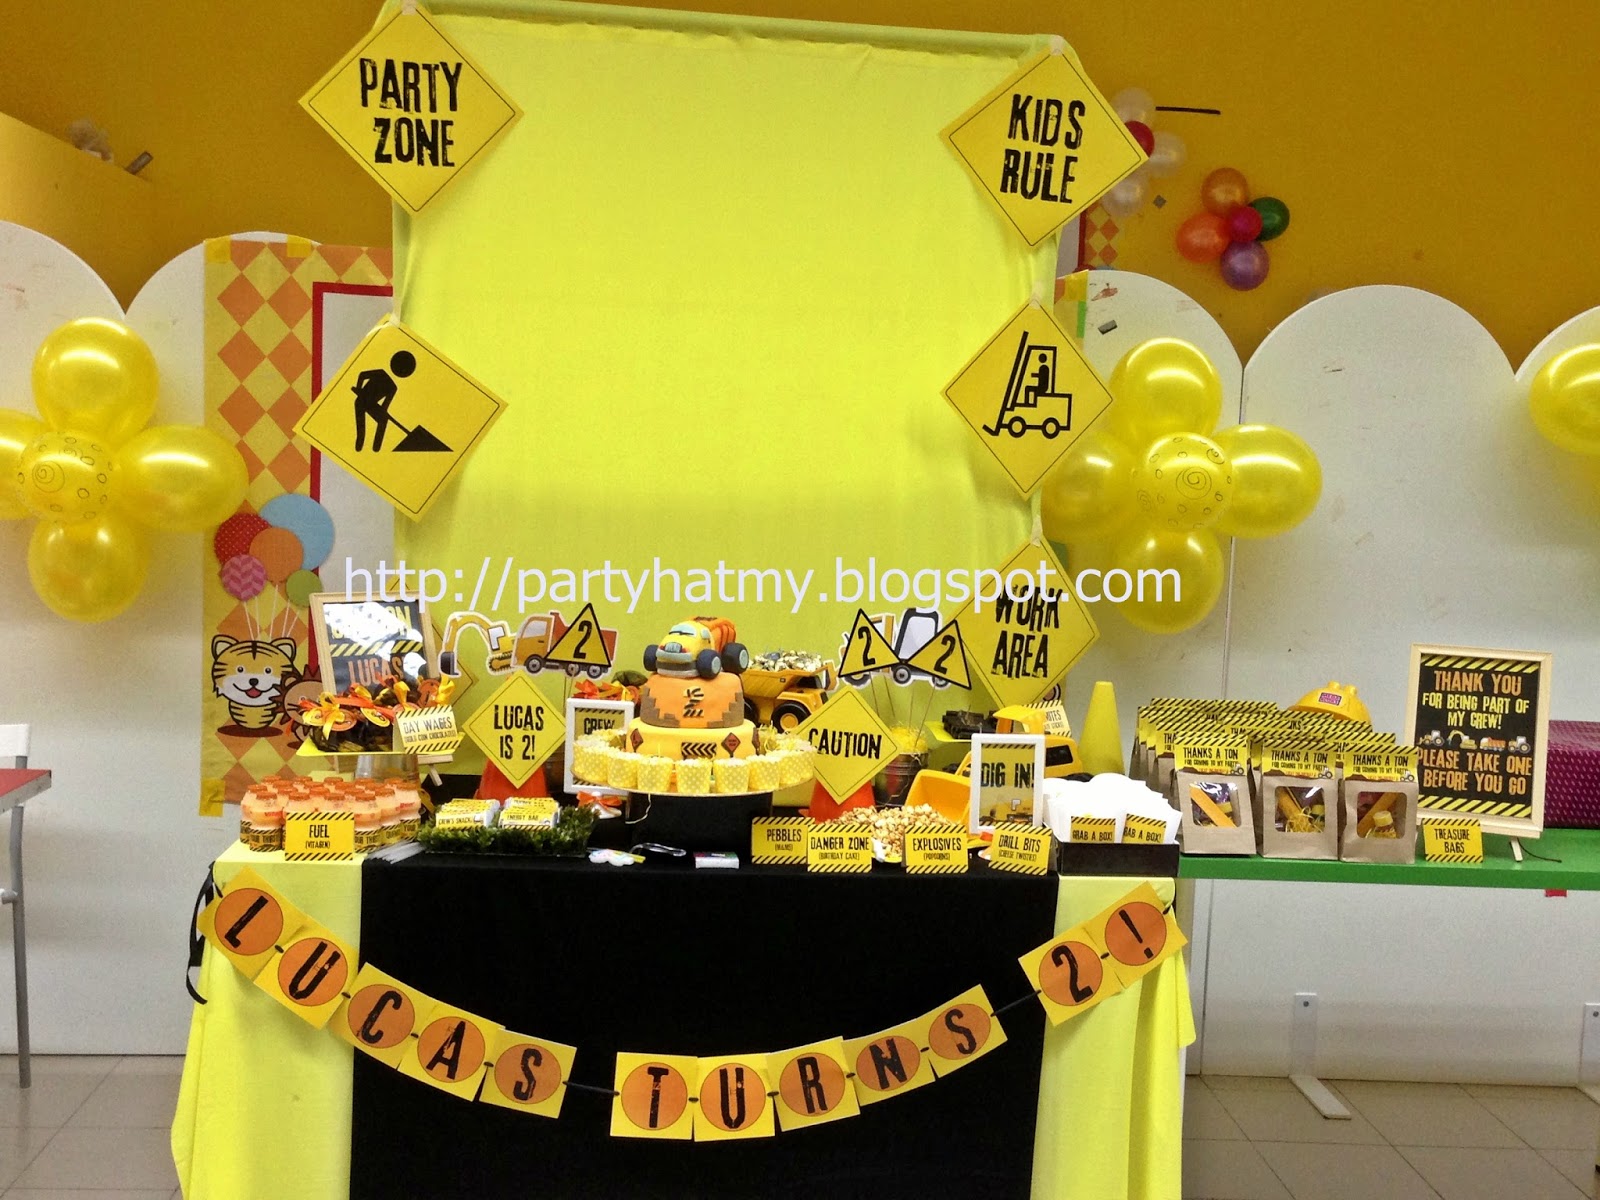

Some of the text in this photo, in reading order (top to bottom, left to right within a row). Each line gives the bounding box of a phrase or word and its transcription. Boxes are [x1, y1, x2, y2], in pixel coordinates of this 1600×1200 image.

[359, 58, 463, 114] PARTY
[1007, 94, 1086, 150] KIDS
[373, 117, 455, 167] ZONE
[1000, 149, 1078, 204] RULE
[994, 584, 1061, 632] WORK
[573, 620, 593, 660] 2
[858, 626, 876, 667] 2
[933, 634, 956, 675] 2
[990, 630, 1048, 679] AREA
[1434, 670, 1522, 696] THANK YOU
[1422, 692, 1530, 714] FOR BEING PART OF
[403, 717, 453, 735] DAY WAGES
[494, 704, 544, 731] LUCAS
[584, 718, 616, 735] CREW
[1447, 711, 1503, 729] MY CREW!
[500, 734, 535, 760] IS 2!
[808, 728, 882, 760] CAUTION
[1183, 747, 1213, 759] THANKS
[1216, 748, 1221, 759] A
[1225, 748, 1238, 760] TON
[1271, 750, 1301, 762] THANKS
[1304, 752, 1309, 762] A
[1313, 752, 1328, 763] TON
[1353, 754, 1382, 766] THANKS
[1385, 755, 1390, 766] A
[1394, 755, 1409, 767] TON
[1417, 748, 1532, 776] PLEASE TAKE ONE
[981, 762, 1035, 788] DIG IN!
[1423, 770, 1527, 795] BEFORE YOU GO
[309, 824, 330, 838] FUEL
[767, 829, 802, 842] PEBBLES
[810, 837, 869, 850] DANGER ZONE
[998, 834, 1041, 852] DRILL BITS
[1072, 830, 1113, 842] GRAB A BOX!
[1138, 830, 1143, 839] A
[1146, 832, 1162, 843] BOX!
[1434, 828, 1470, 840] TREASURE
[912, 838, 962, 851] EXPLOSIVES
[1444, 842, 1465, 854] BAGS
[224, 895, 542, 1101] LUCAS
[646, 1007, 977, 1129] TURNS
